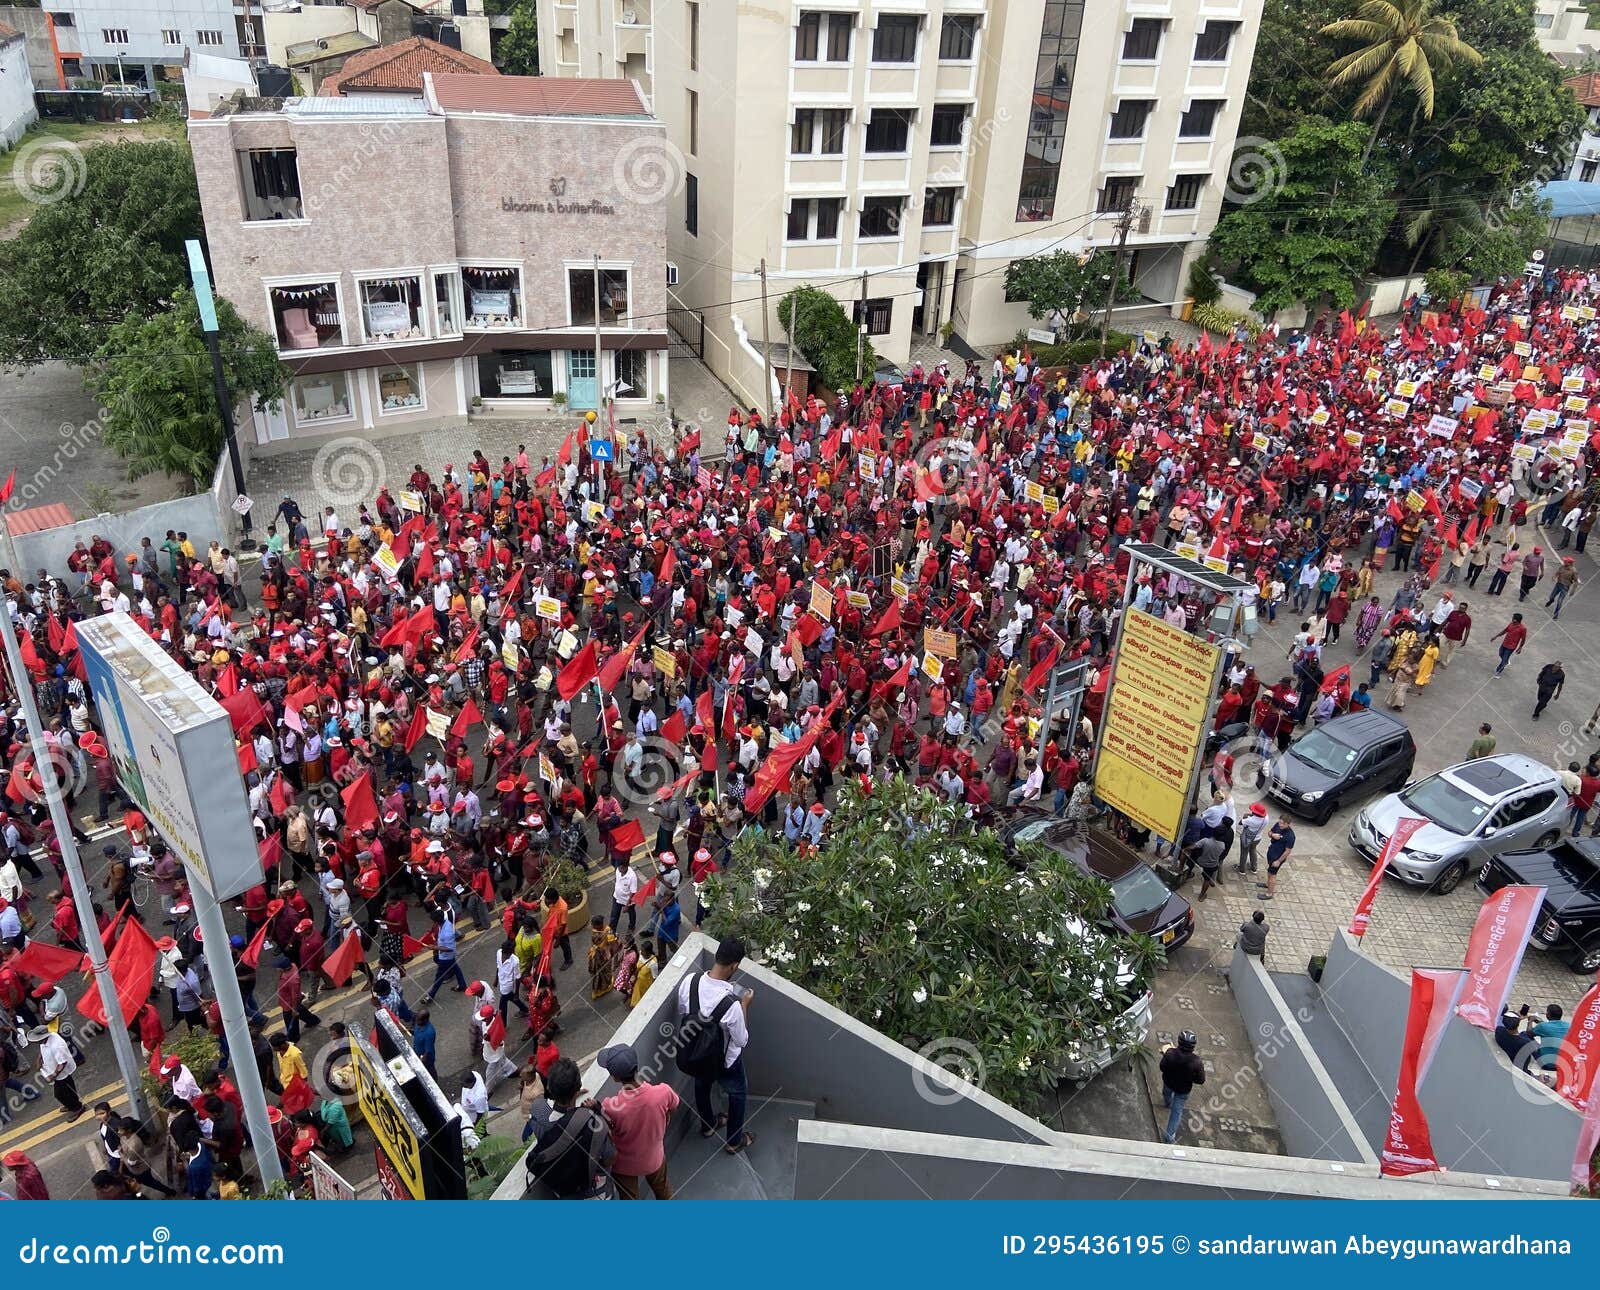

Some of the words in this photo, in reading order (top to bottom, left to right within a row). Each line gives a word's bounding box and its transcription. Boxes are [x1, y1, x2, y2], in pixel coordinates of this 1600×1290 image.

[502, 197, 545, 212] blooms
[556, 199, 615, 215] butterflies
[1127, 673, 1166, 698] Language
[1167, 693, 1190, 710] Class
[1127, 704, 1137, 714] and
[1111, 719, 1134, 736] Lecture
[1135, 732, 1155, 748] Room
[1155, 743, 1185, 764] Facilities
[1106, 741, 1126, 757] Modern
[1126, 752, 1155, 774] Auditorium
[1156, 769, 1181, 788] Facilities
